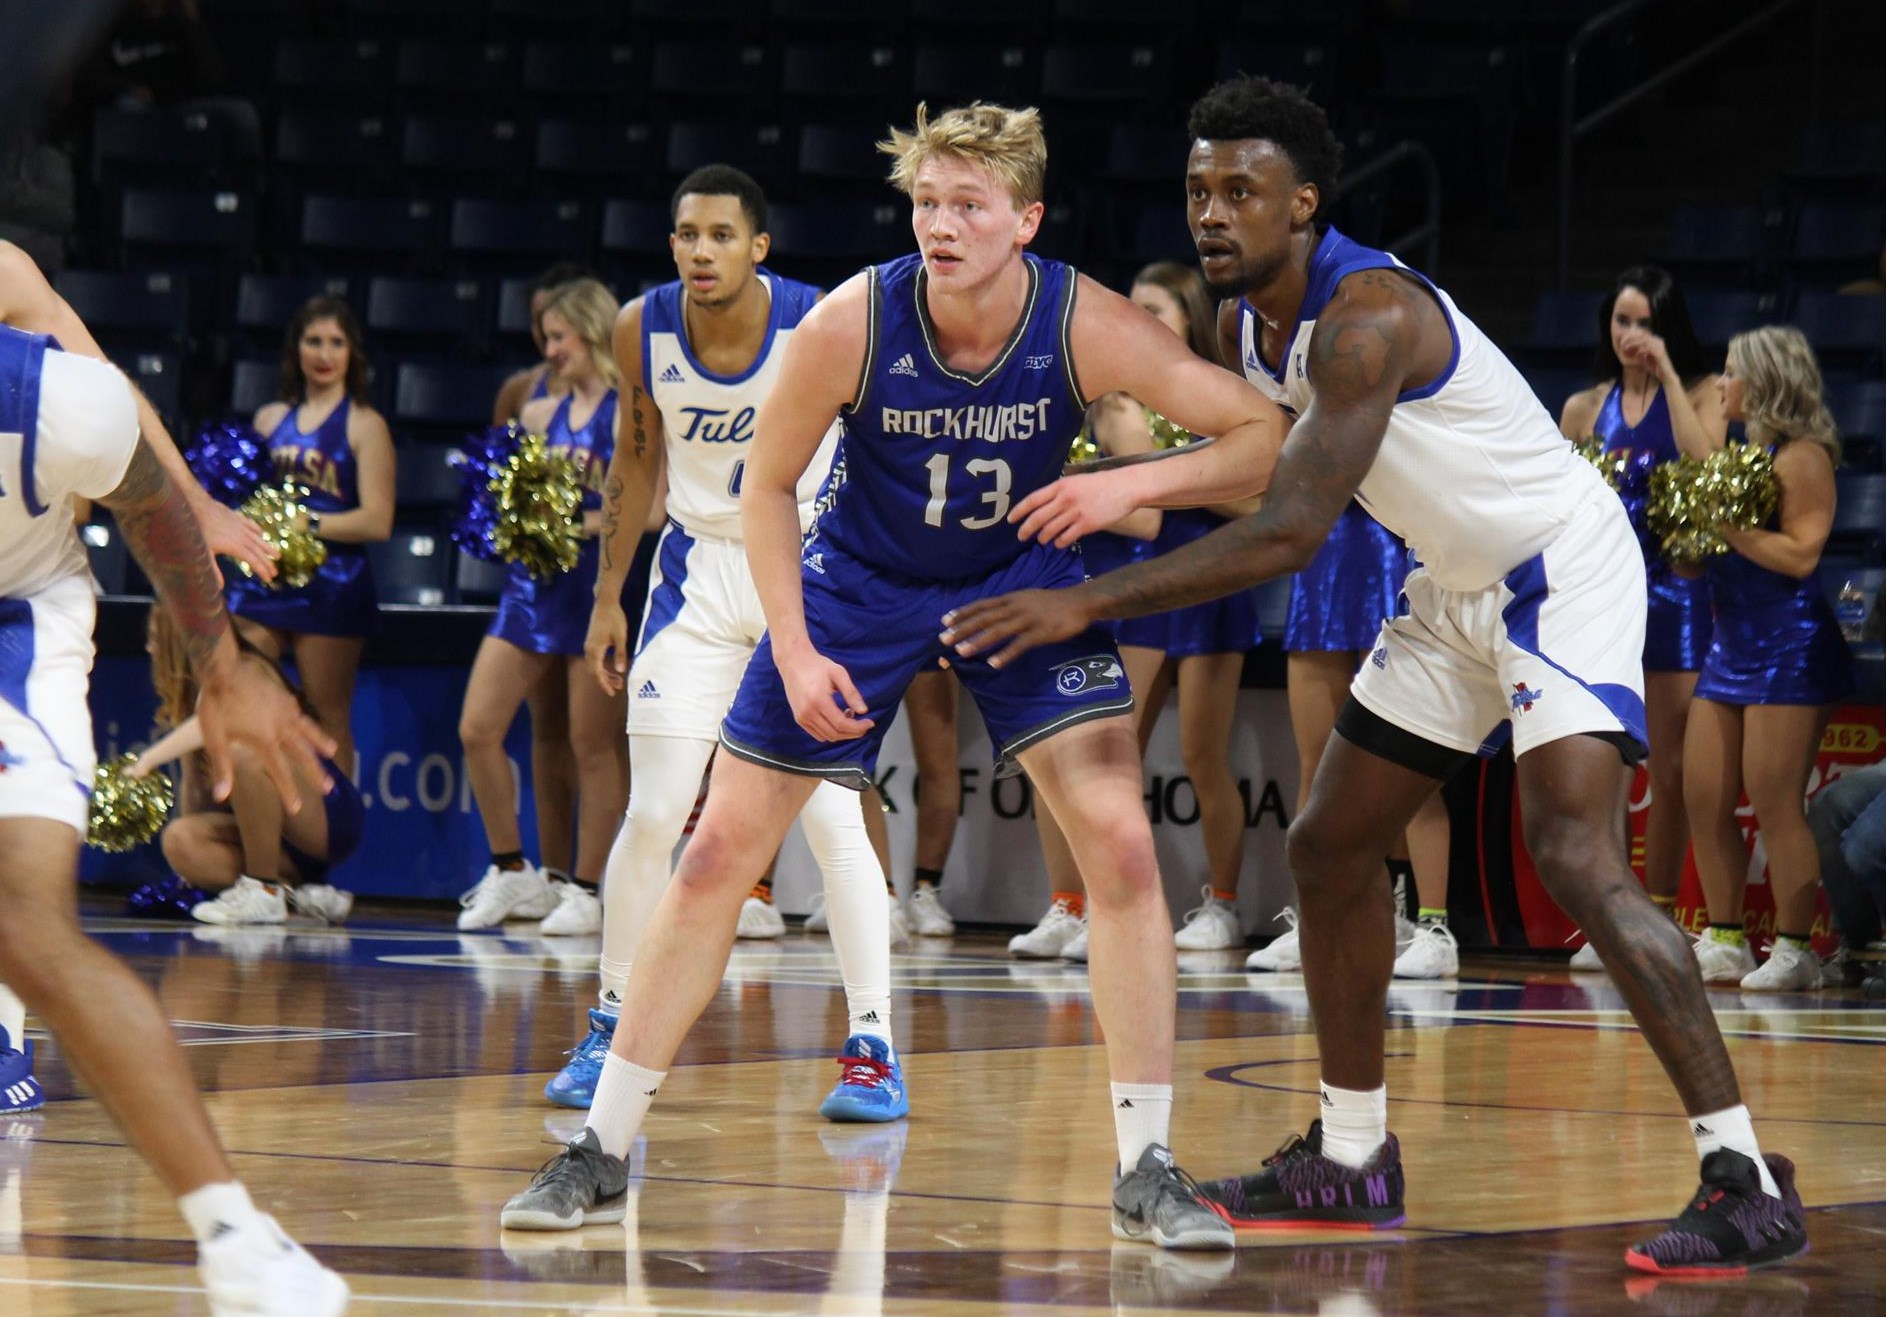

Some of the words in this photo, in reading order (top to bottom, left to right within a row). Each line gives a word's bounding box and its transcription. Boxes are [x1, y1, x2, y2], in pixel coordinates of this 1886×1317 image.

[889, 367, 918, 378] adidas
[882, 398, 1051, 443] ROCKHURST
[925, 453, 1013, 530] 13
